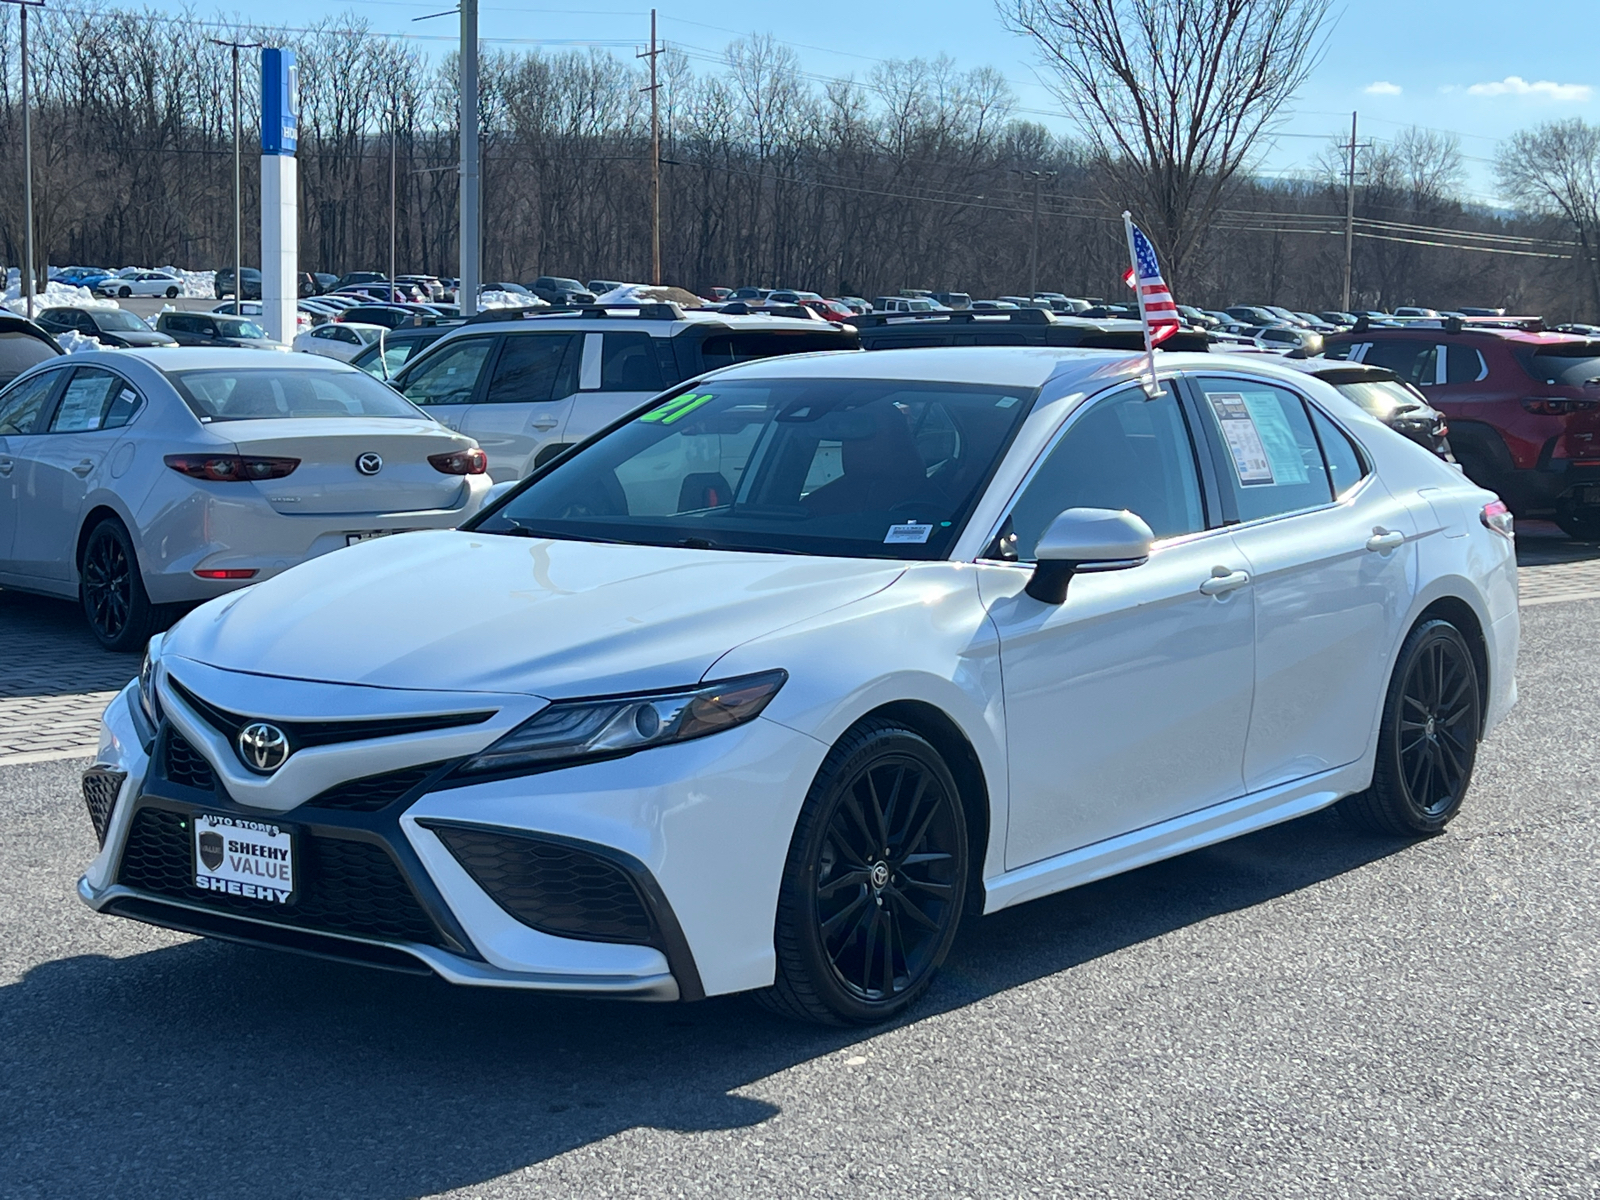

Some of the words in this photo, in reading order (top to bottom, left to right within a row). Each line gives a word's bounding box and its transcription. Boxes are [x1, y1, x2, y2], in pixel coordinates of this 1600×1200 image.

[640, 394, 713, 424] 21
[202, 814, 232, 826] AUTO
[235, 820, 279, 834] STORES
[228, 840, 288, 861] SHEEHY
[229, 855, 290, 880] VALUE
[196, 876, 291, 904] SHEEHY
